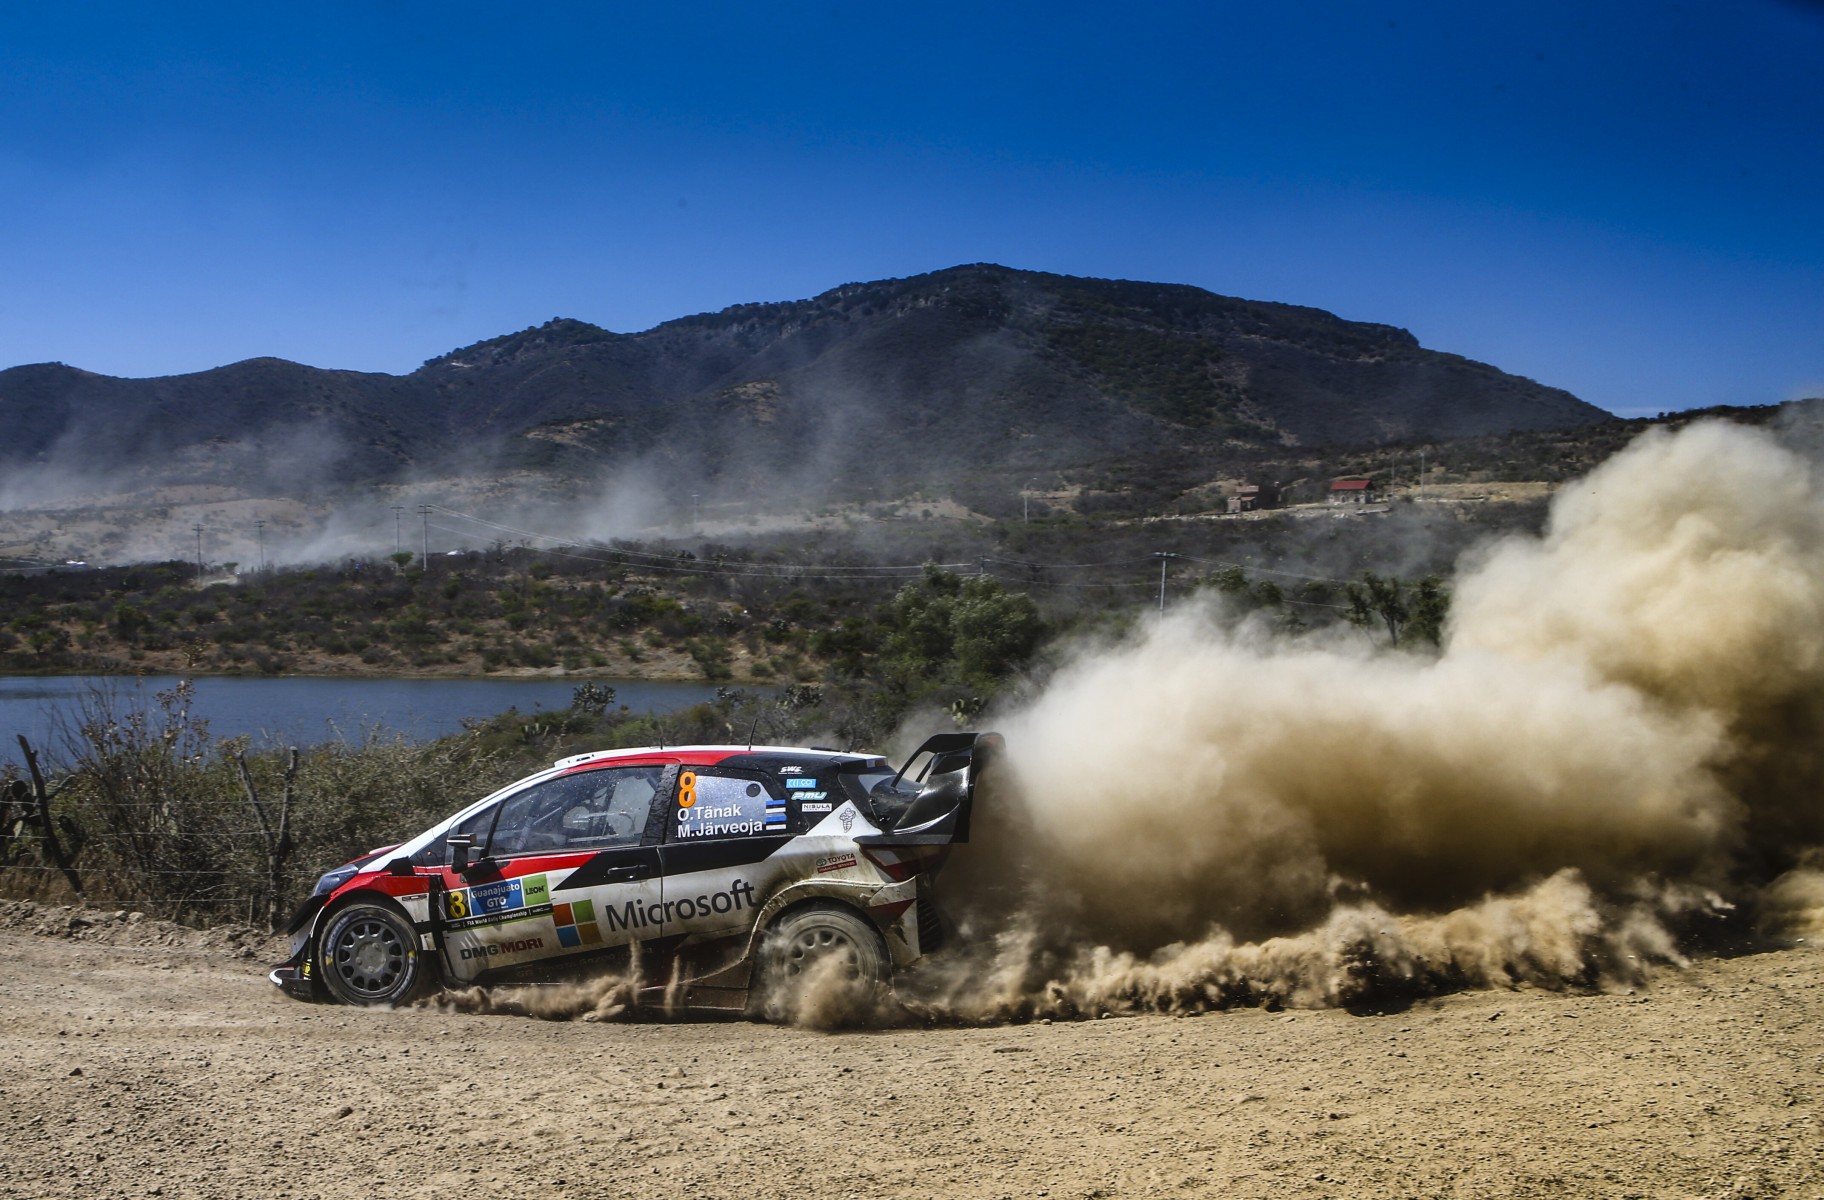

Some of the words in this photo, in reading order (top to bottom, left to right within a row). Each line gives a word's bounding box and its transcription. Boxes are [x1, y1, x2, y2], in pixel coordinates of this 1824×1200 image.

[678, 771, 697, 808] 8
[677, 803, 742, 822] O.Tänak
[677, 819, 763, 839] M.Järveoja
[827, 853, 856, 864] TOYOTA
[471, 883, 520, 899] Guanajuato
[449, 891, 466, 919] 8
[486, 896, 507, 908] GTO
[605, 878, 758, 932] Microsoft
[460, 944, 499, 960] DMG
[499, 938, 545, 954] MORI
